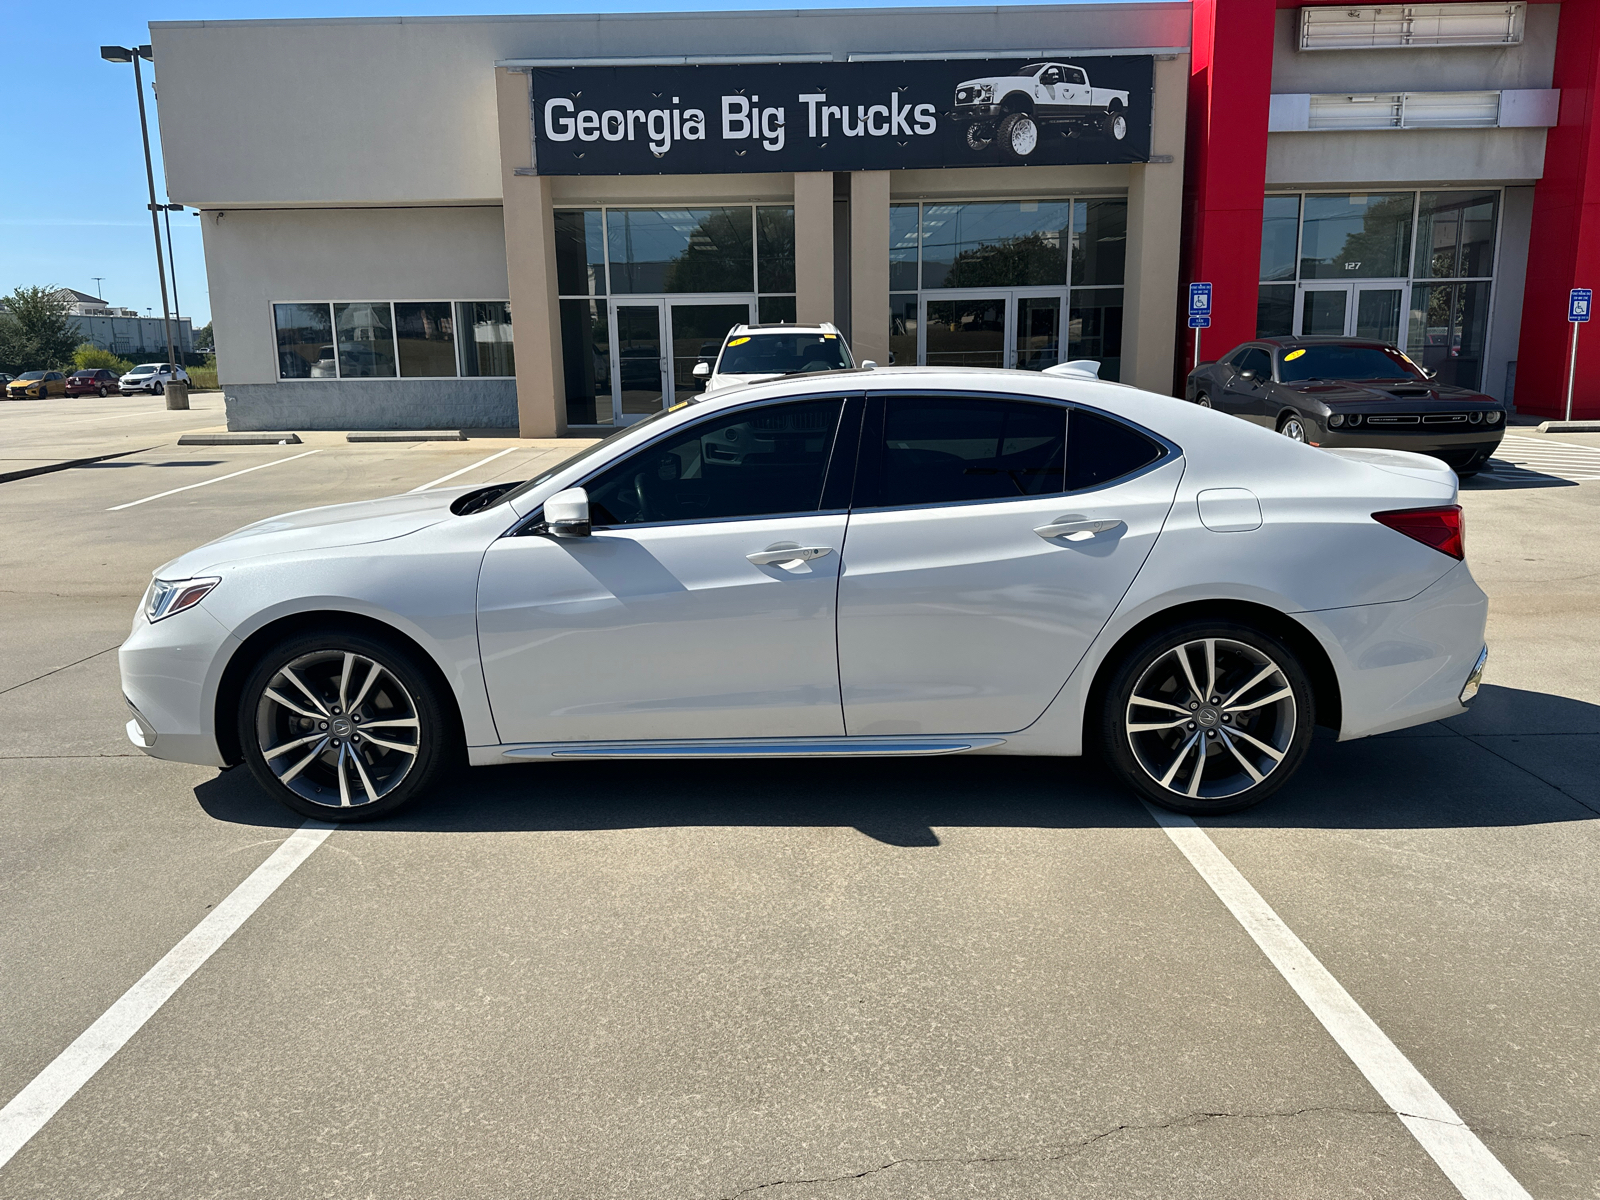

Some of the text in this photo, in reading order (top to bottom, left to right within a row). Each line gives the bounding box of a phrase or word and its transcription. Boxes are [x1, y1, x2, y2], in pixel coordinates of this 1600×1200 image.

[544, 91, 937, 153] Georgia Big Trucks
[1344, 262, 1362, 270] 127
[281, 639, 313, 654] VELOCITY
[1300, 680, 1311, 715] VELOCITY
